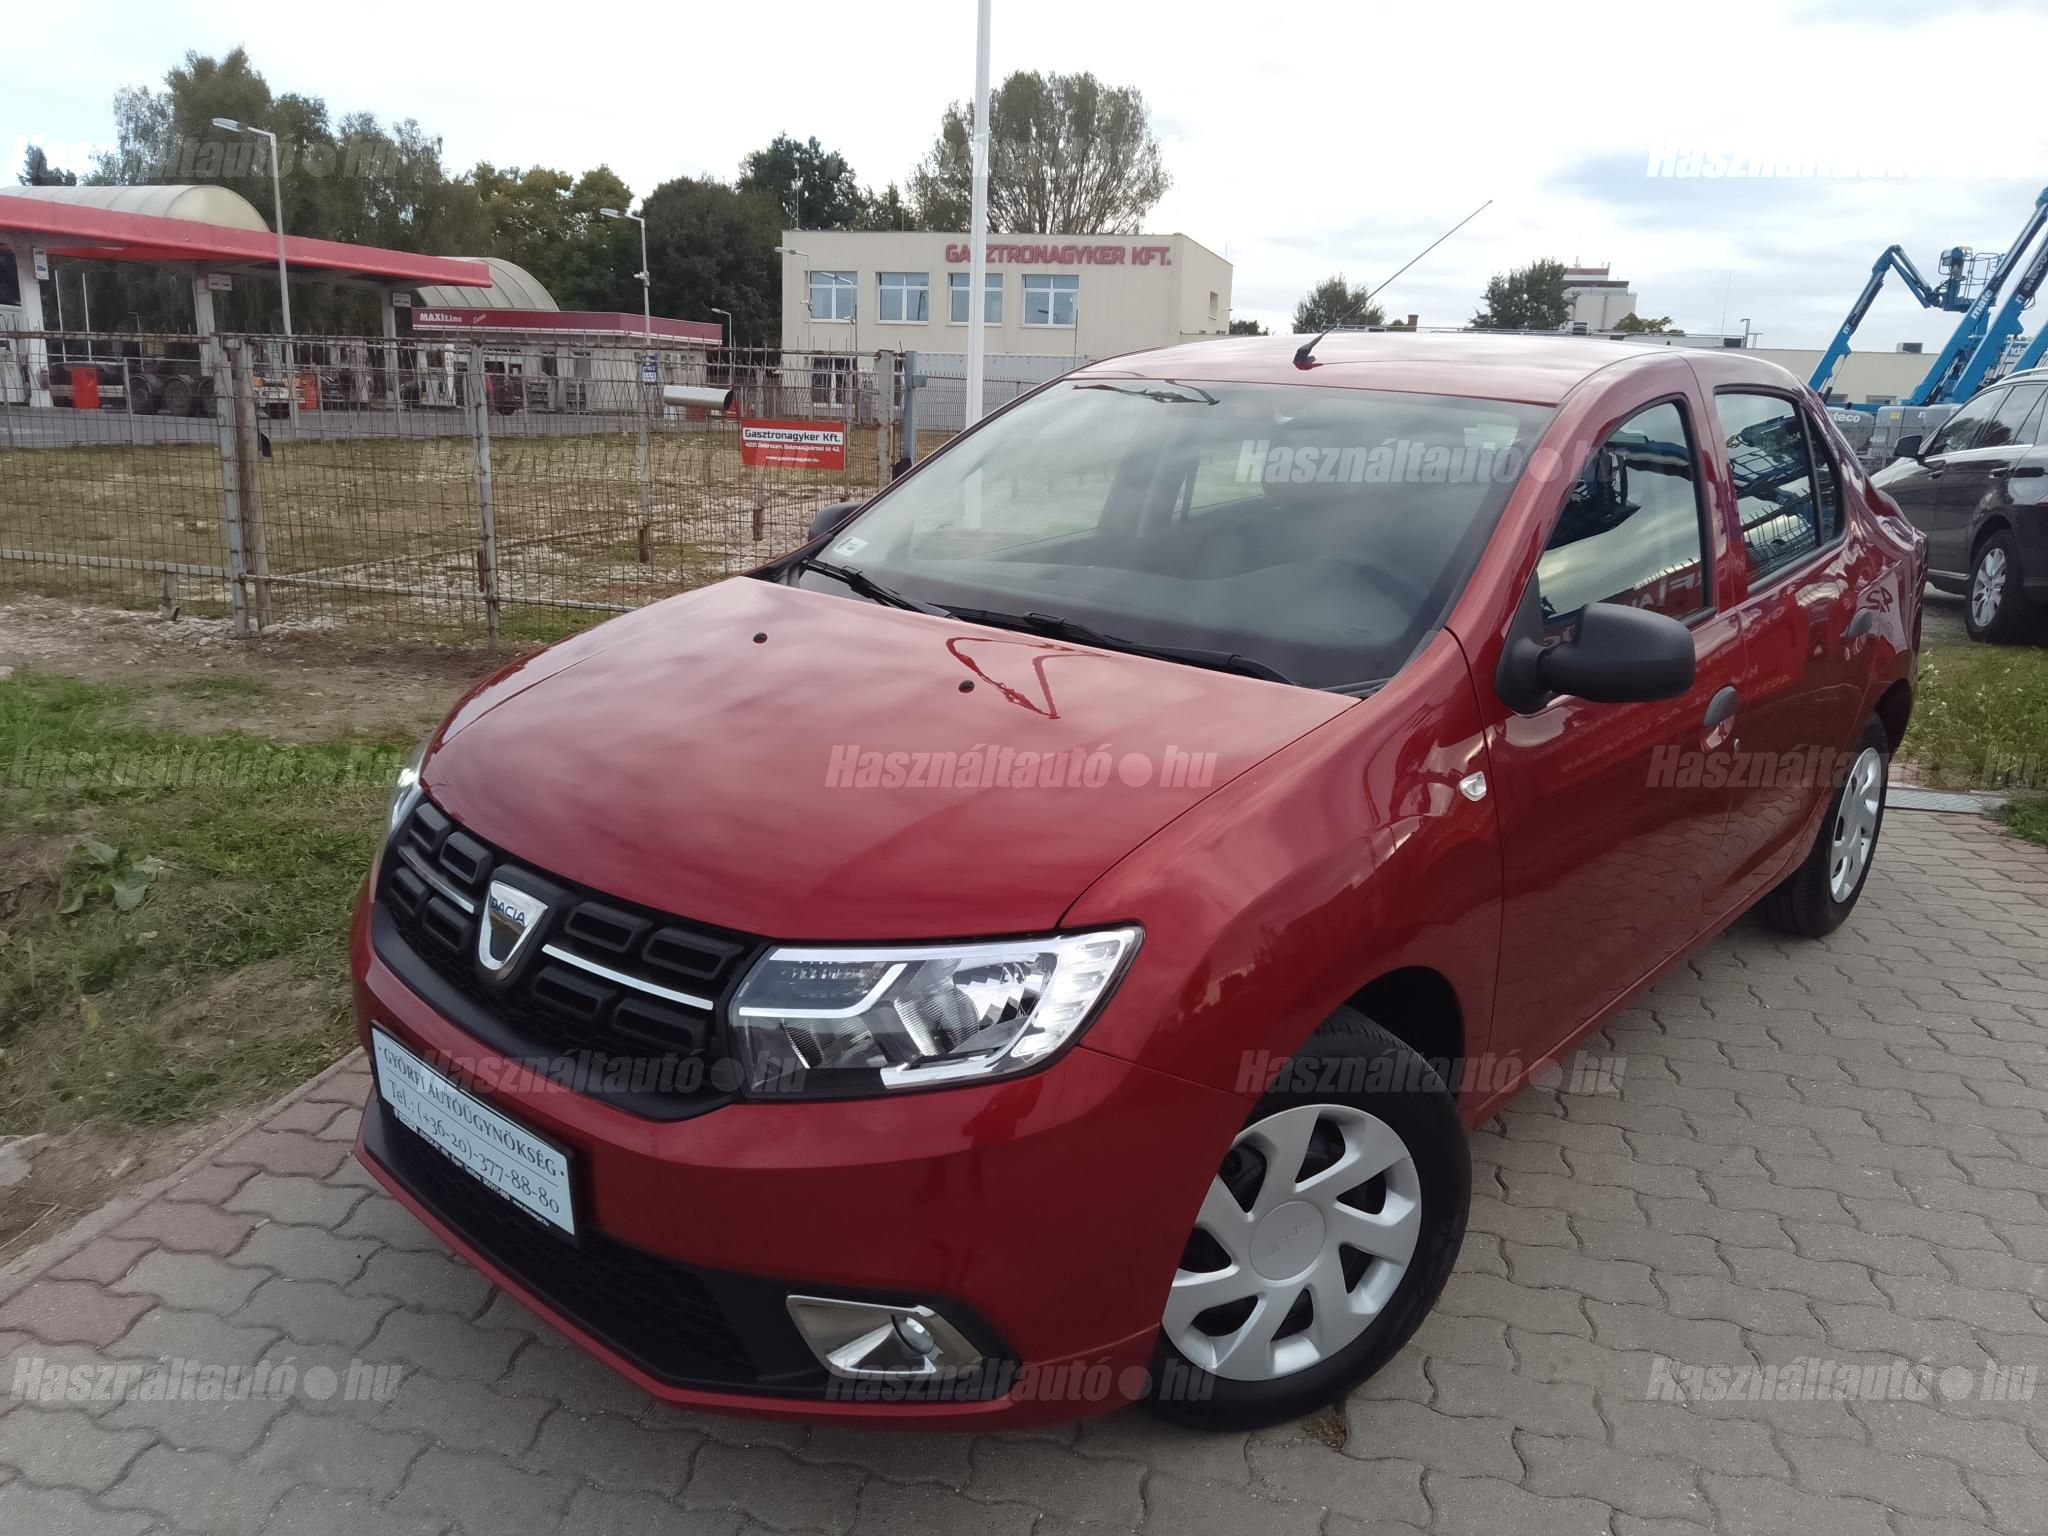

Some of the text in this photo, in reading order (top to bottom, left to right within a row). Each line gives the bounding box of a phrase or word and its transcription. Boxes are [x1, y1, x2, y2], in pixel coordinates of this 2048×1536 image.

[945, 244, 1172, 266] GAZTRONAGYKER KFT.
[745, 429, 841, 442] Gasztronagyker Kft.
[489, 896, 526, 925] DACIA
[428, 1082, 557, 1177] AUTÓÜGYNÖKSÉG
[417, 1101, 560, 1214] (+36-20)-377-88-80
